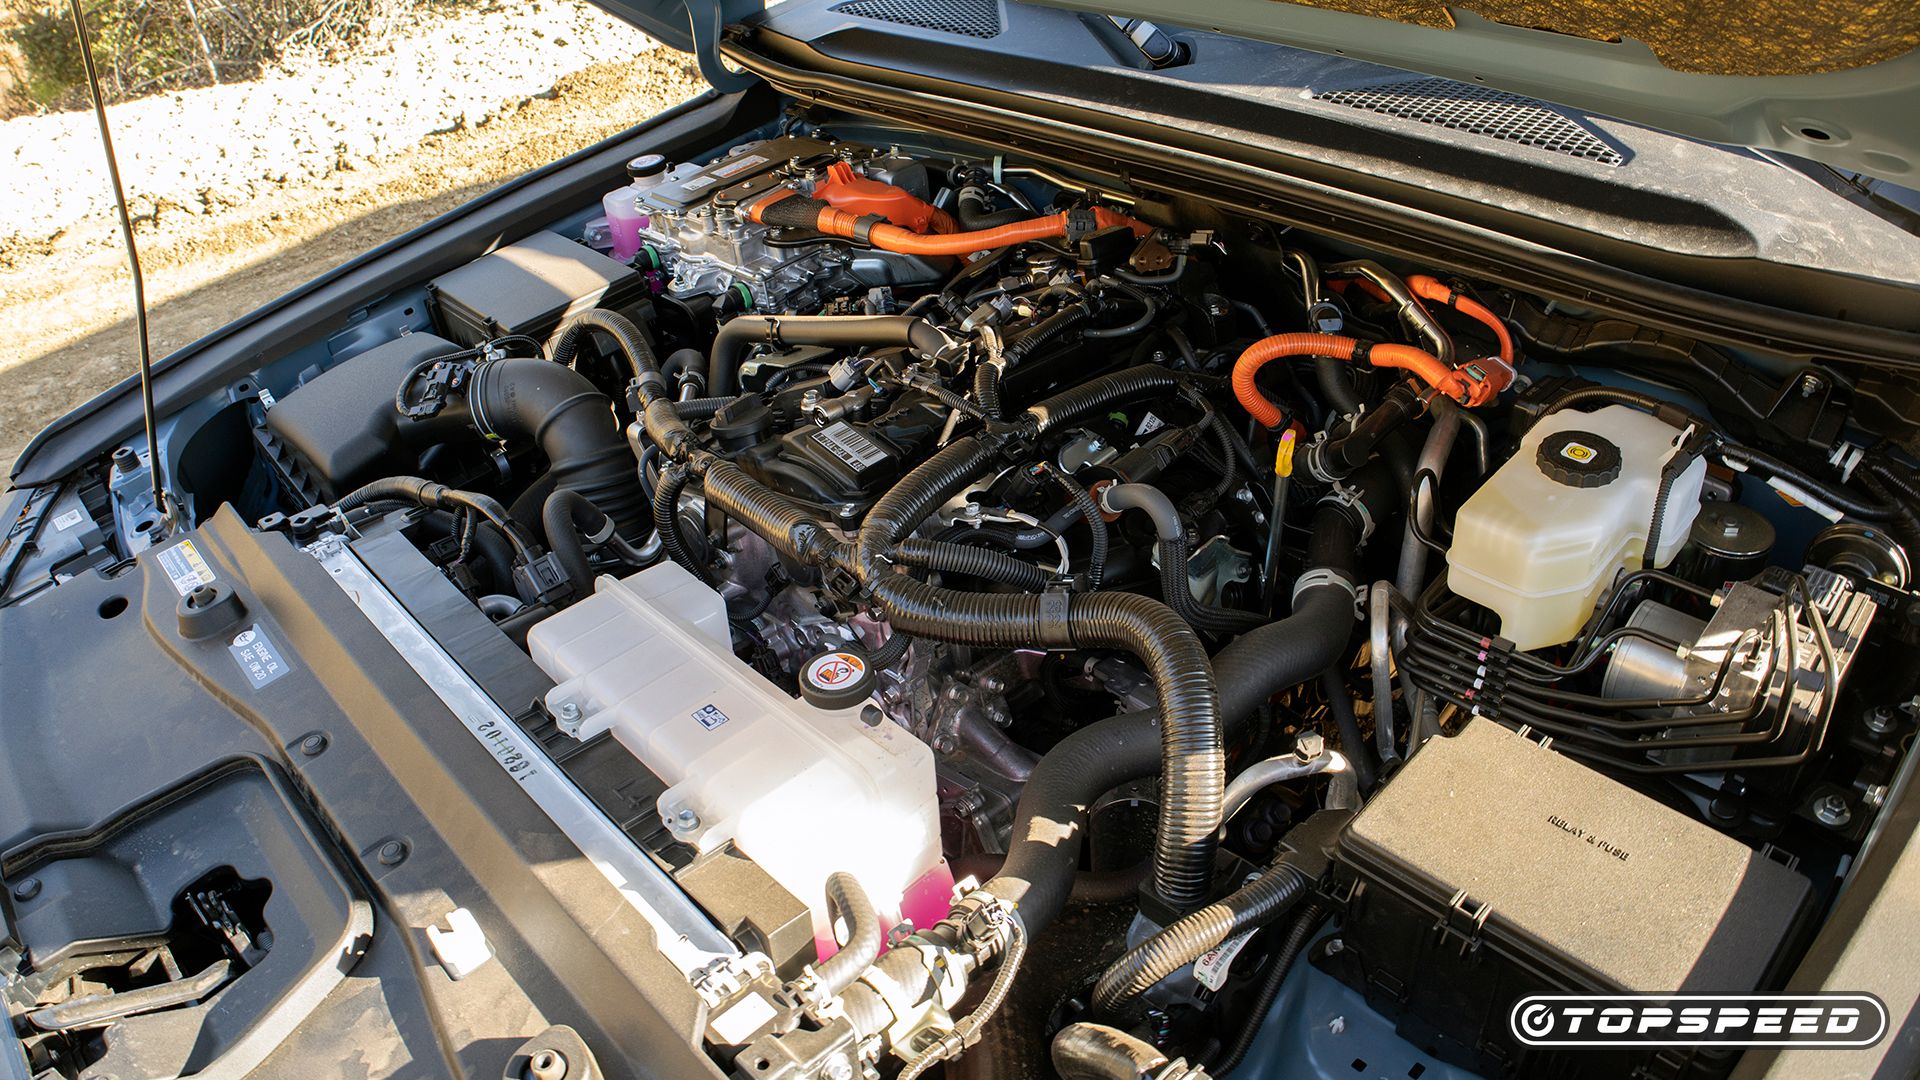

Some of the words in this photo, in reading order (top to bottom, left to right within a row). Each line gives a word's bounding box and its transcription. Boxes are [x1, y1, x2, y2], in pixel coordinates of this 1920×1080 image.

[240, 648, 255, 663] SAE
[248, 661, 267, 681] 0W-20
[252, 641, 273, 663] ENGINE
[266, 661, 279, 674] OIL
[1546, 815, 1586, 838] RELAY
[1586, 835, 1597, 845] &
[1597, 840, 1630, 862] FUSE
